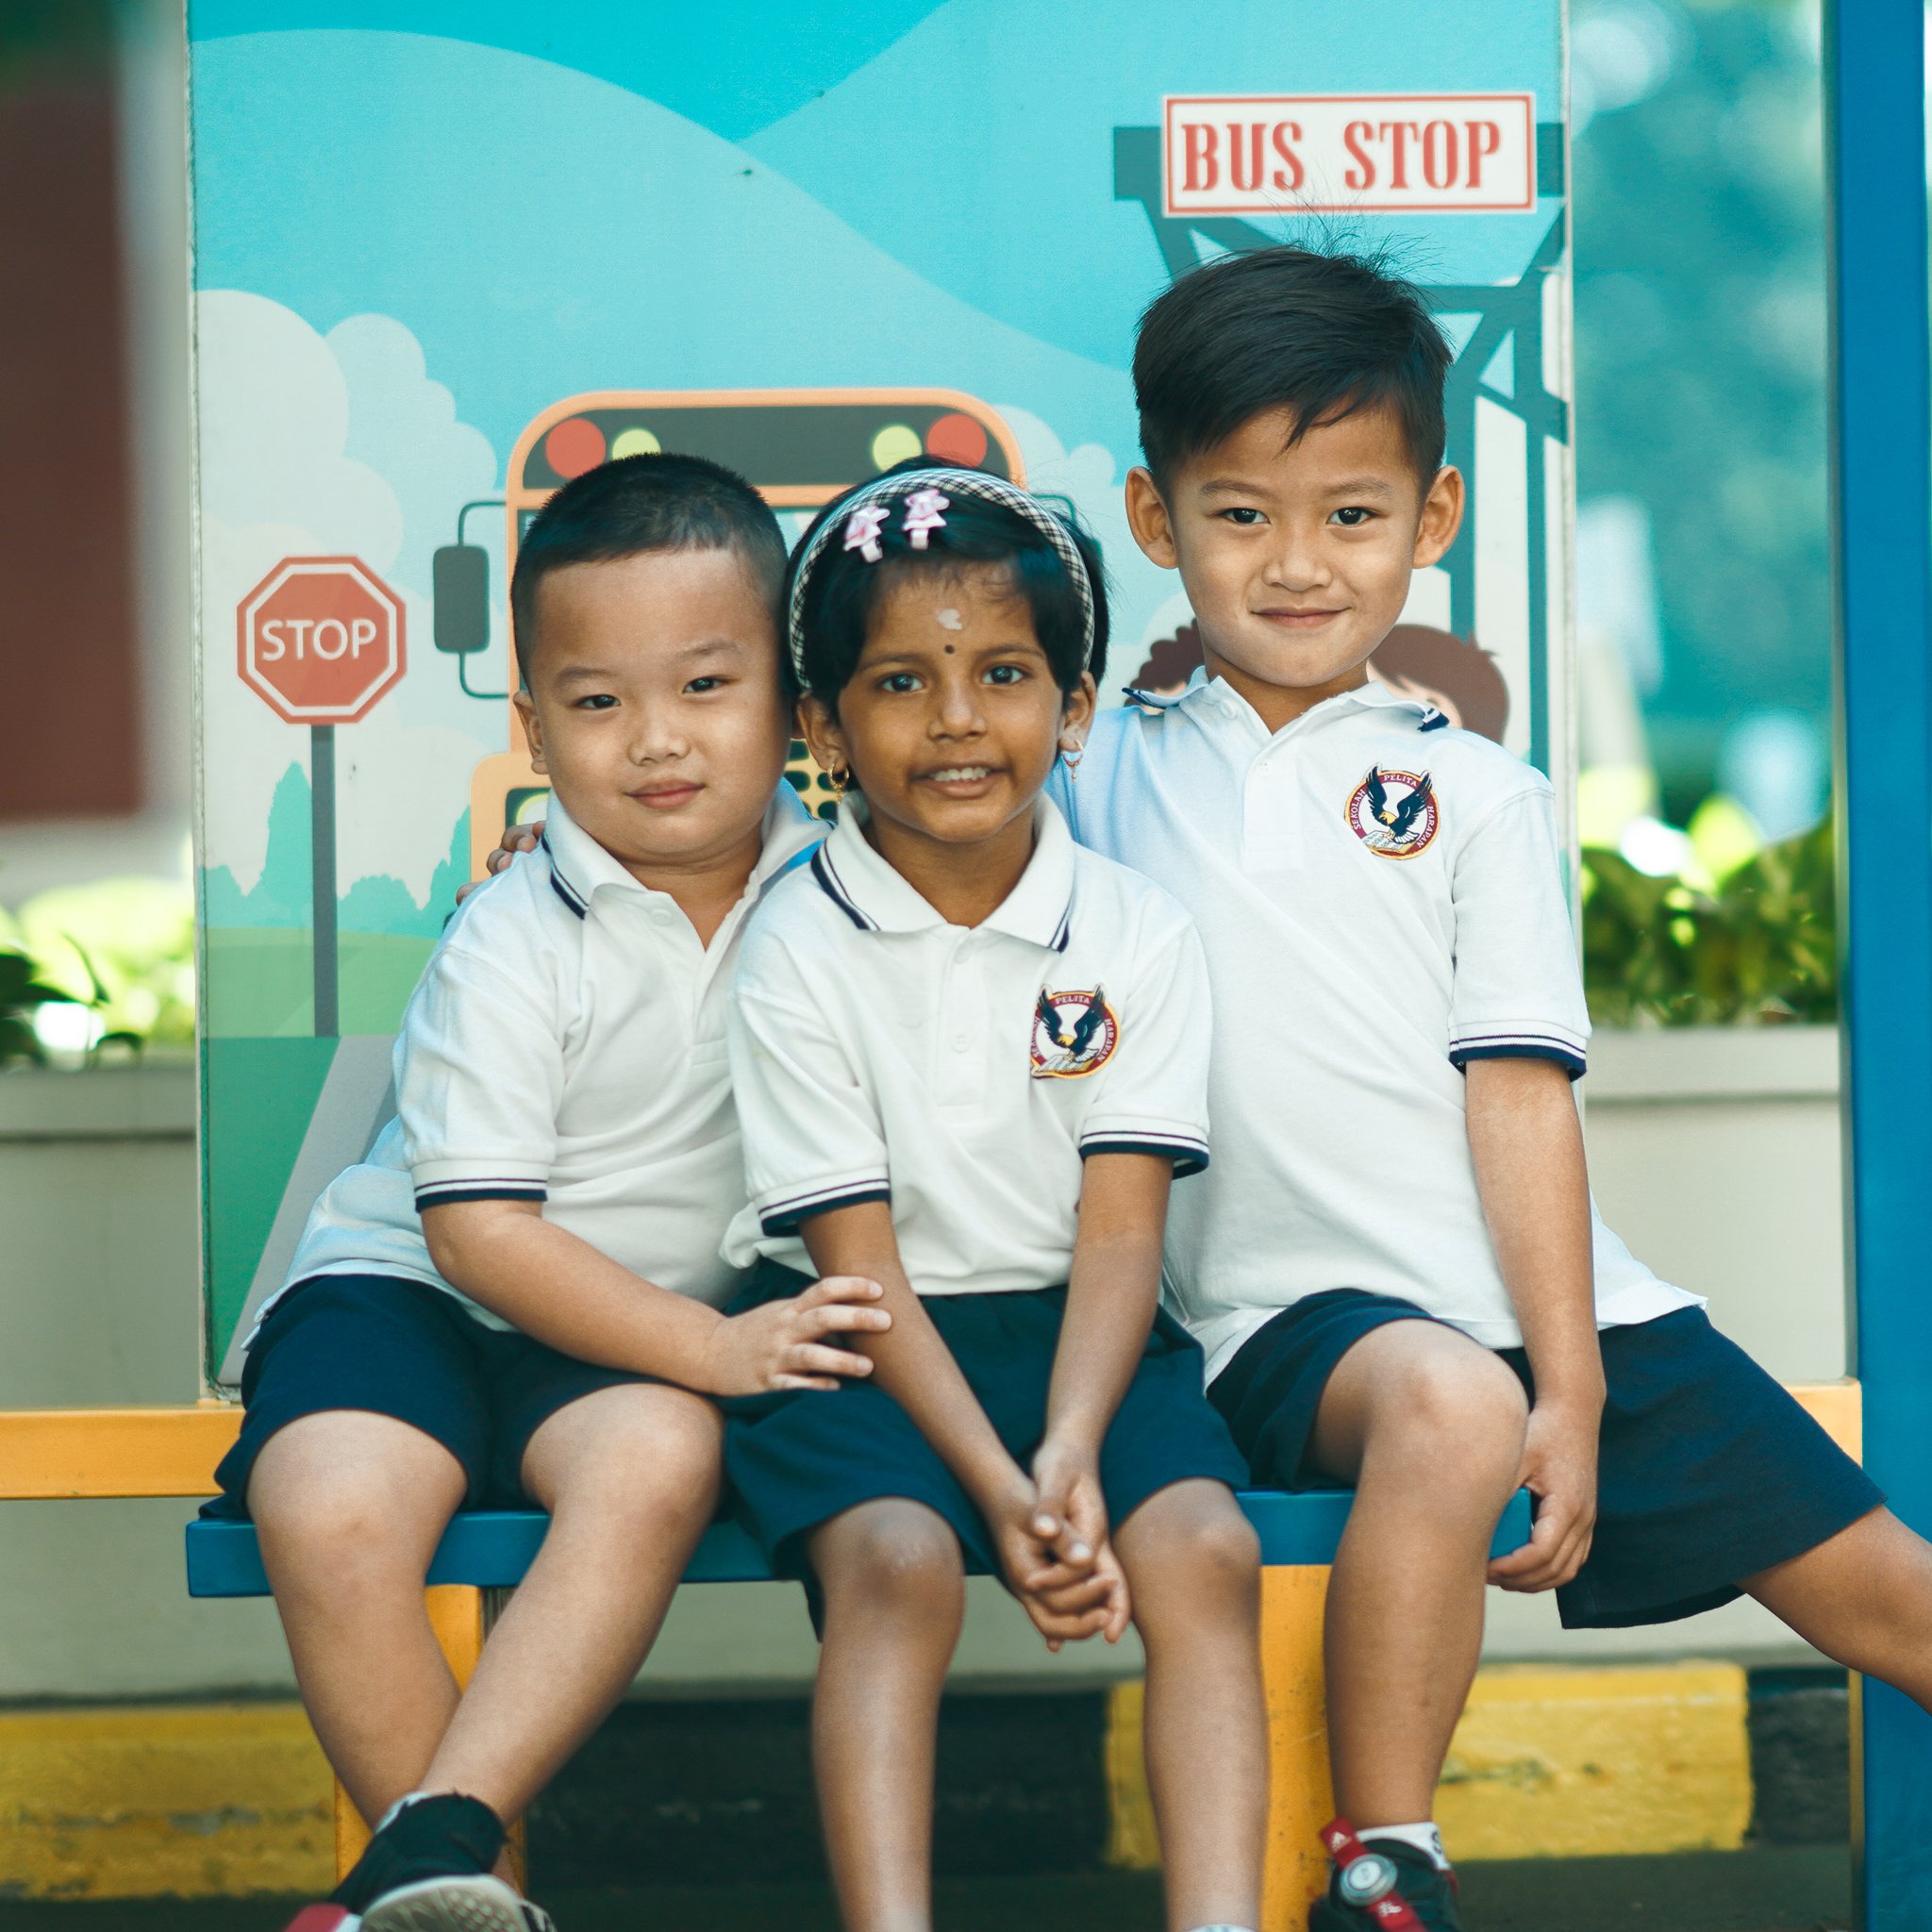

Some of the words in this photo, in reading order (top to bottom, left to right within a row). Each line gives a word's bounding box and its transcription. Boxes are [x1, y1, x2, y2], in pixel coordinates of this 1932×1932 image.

[1180, 121, 1305, 192] BUS
[1343, 120, 1501, 191] STOP
[261, 619, 376, 661] STOP
[1350, 789, 1367, 830] SEKOLAH
[1384, 774, 1417, 787] PELITA
[1417, 806, 1435, 848] HARAPAN
[1055, 995, 1090, 1005] PELITA
[1097, 1018, 1115, 1062] HARAPAN
